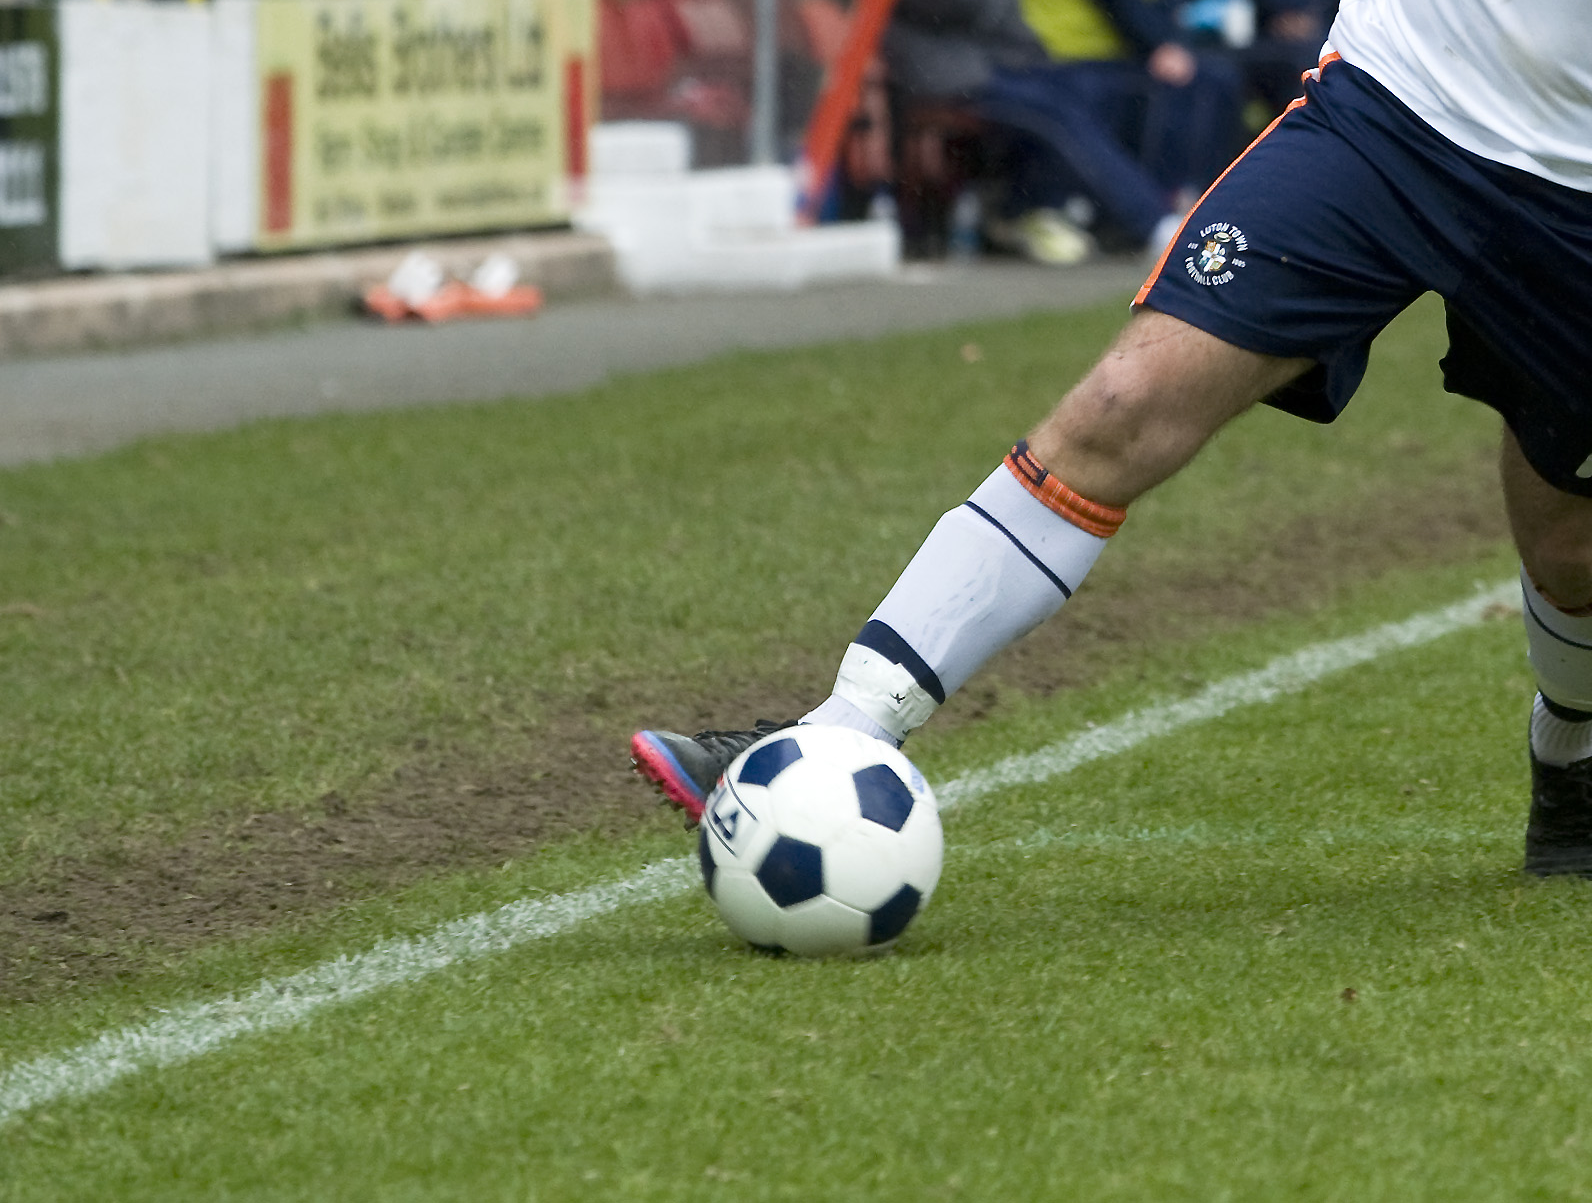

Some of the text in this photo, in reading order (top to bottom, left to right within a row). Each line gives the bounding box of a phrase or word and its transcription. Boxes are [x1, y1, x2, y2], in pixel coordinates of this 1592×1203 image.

[1200, 222, 1249, 252] LUTON TOWN
[1184, 256, 1212, 286] FOOTBALL
[1211, 270, 1235, 286] CLUB
